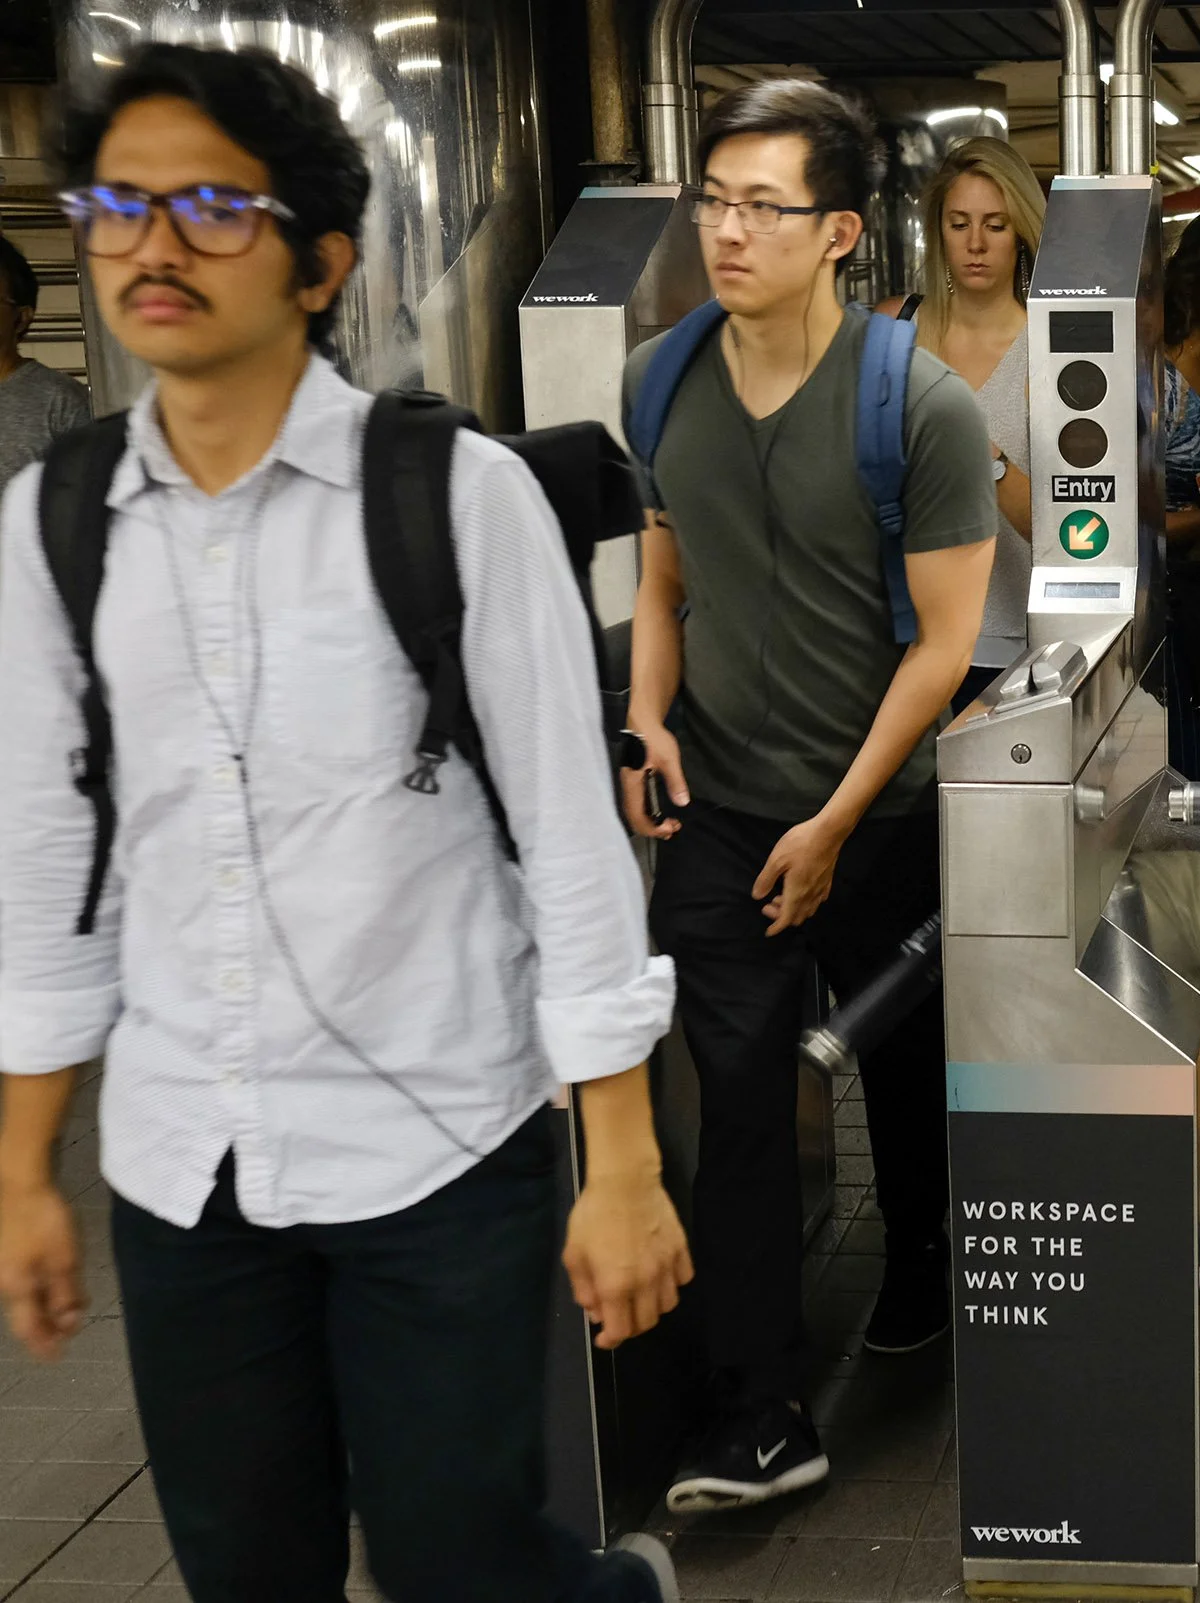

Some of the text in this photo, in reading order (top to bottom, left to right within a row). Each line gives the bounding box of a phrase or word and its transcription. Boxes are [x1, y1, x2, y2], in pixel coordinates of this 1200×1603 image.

[532, 293, 599, 303] wework
[1039, 286, 1107, 295] wework
[1053, 476, 1114, 501] Entry
[963, 1201, 1134, 1222] WORKSPACE
[965, 1236, 1082, 1256] FOR THE
[965, 1271, 1084, 1291] WAY YOU
[965, 1306, 1047, 1325] THINK
[971, 1521, 1081, 1543] wework
